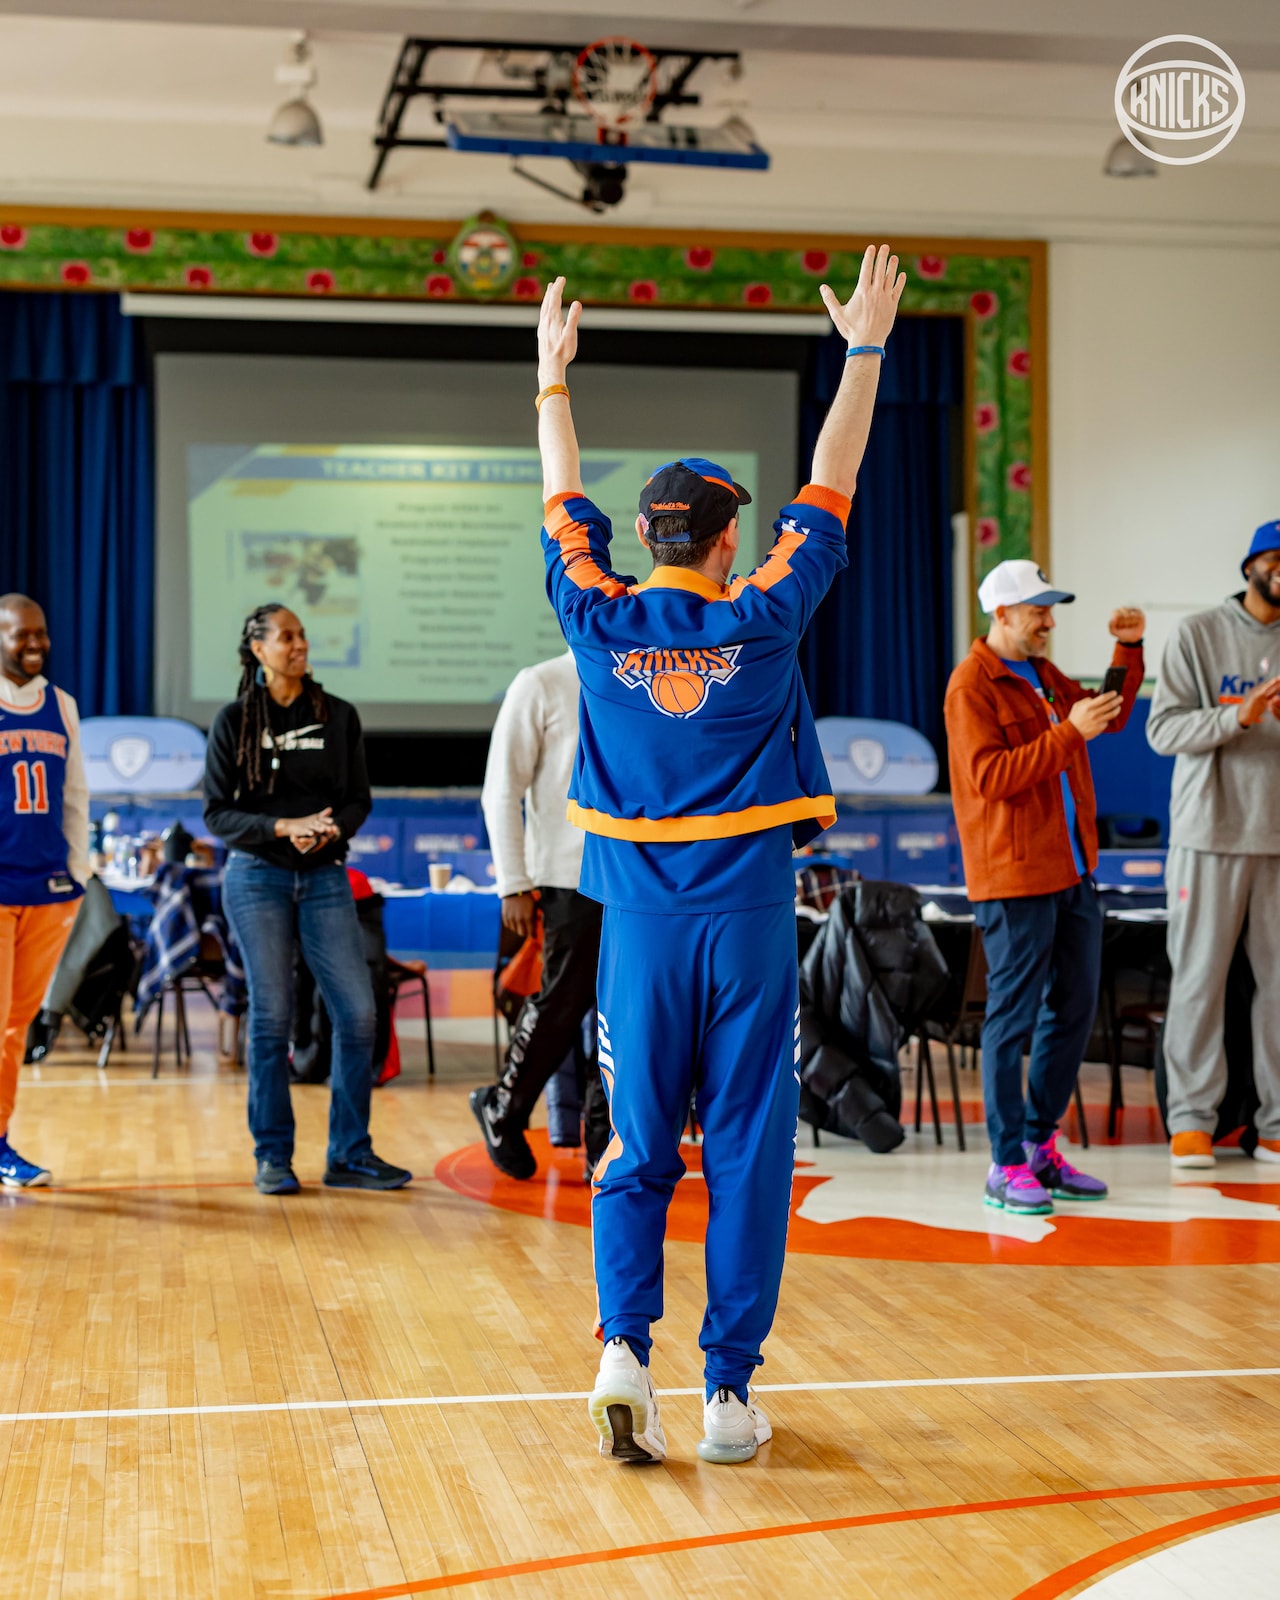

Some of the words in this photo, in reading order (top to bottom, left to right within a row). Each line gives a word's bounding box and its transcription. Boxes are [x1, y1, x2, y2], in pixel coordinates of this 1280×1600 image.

[321, 460, 427, 479] TEACHER
[431, 462, 470, 479] KIT
[617, 646, 734, 676] KNICKS
[0, 729, 23, 756] EW
[12, 760, 49, 814] 11
